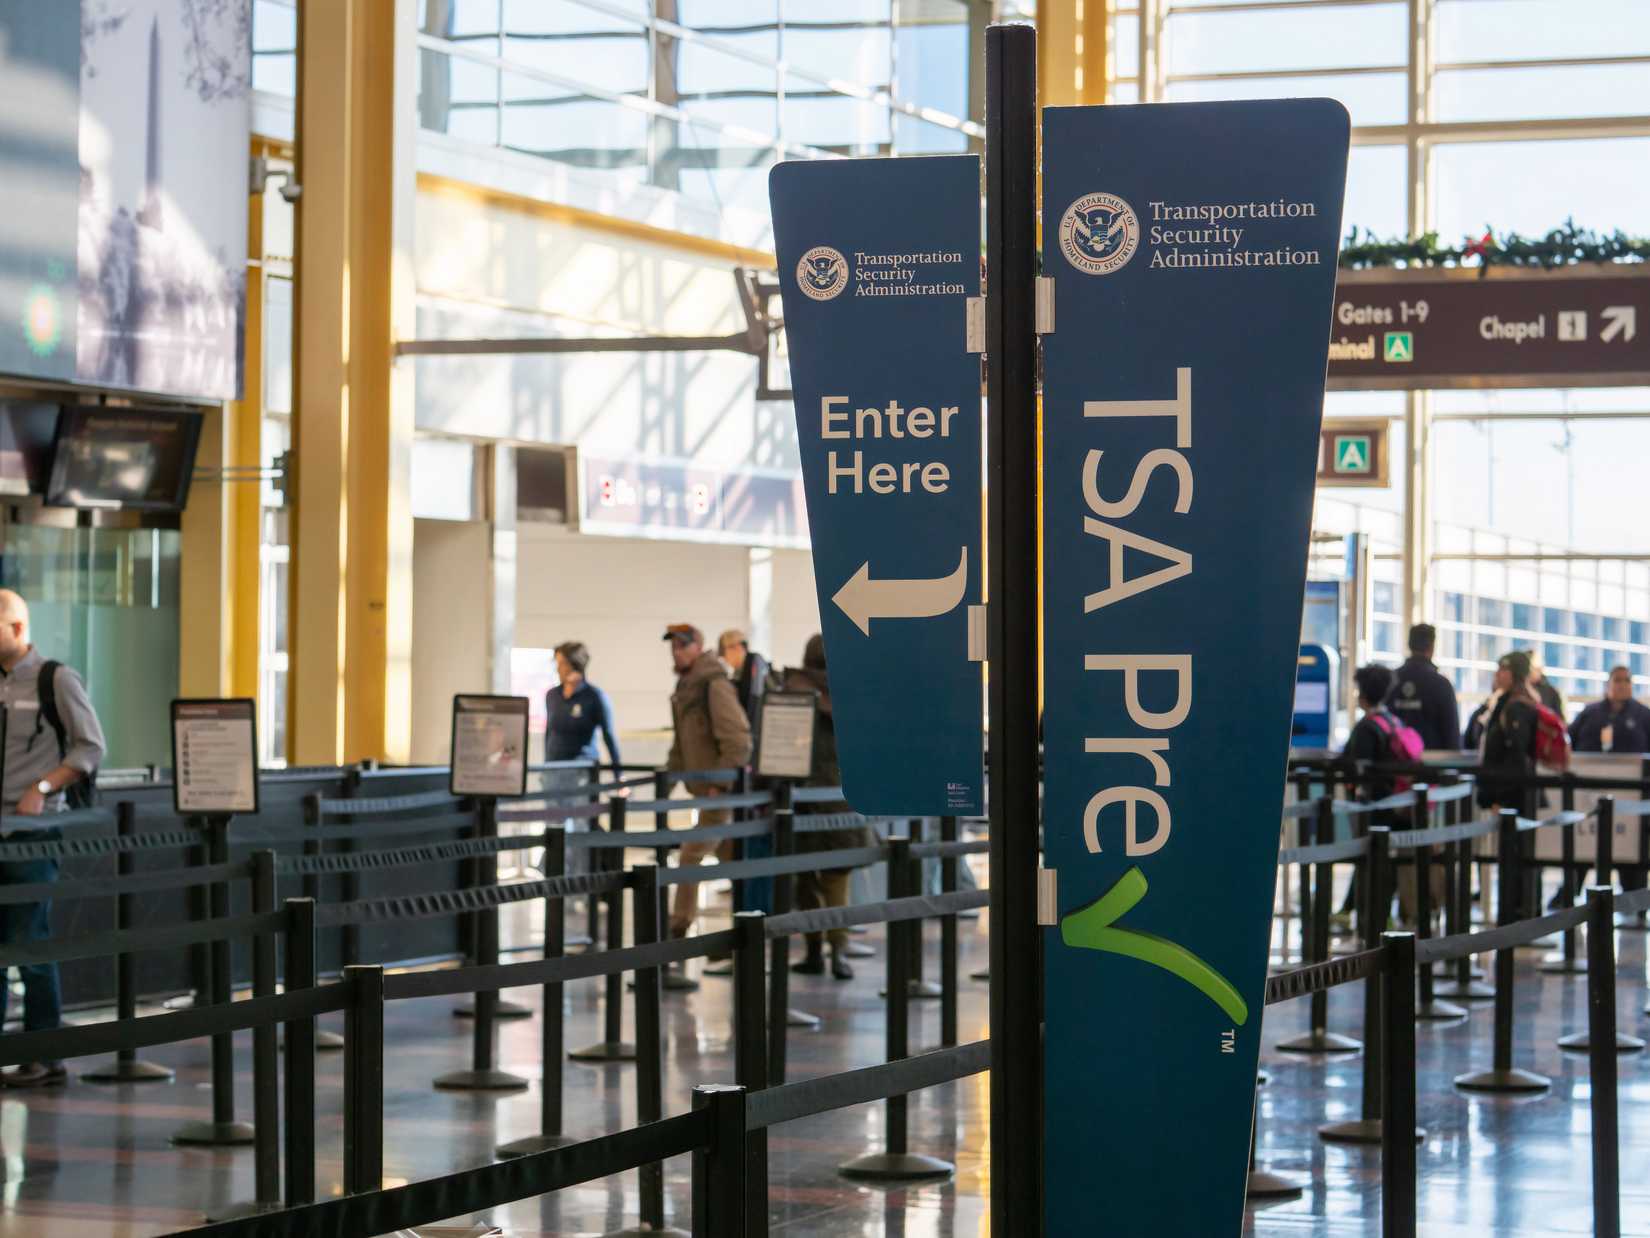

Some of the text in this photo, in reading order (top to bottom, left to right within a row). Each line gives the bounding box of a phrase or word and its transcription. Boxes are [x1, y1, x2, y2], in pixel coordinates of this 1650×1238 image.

[1075, 196, 1129, 216] DEPARTMENT
[1149, 199, 1317, 225] Transportation
[1150, 225, 1244, 248] Security
[854, 250, 963, 268] Transportation
[1063, 238, 1136, 271] HOMELAND SECURITY
[1149, 247, 1321, 269] Administration
[855, 267, 916, 283] Security
[854, 282, 966, 297] Administration
[1337, 300, 1430, 325] Gates 1-9
[1479, 313, 1546, 344] Chapel
[821, 395, 959, 439] Enter
[1340, 440, 1366, 470] A
[828, 451, 950, 494] Here
[1081, 367, 1194, 857] TSA Pre
